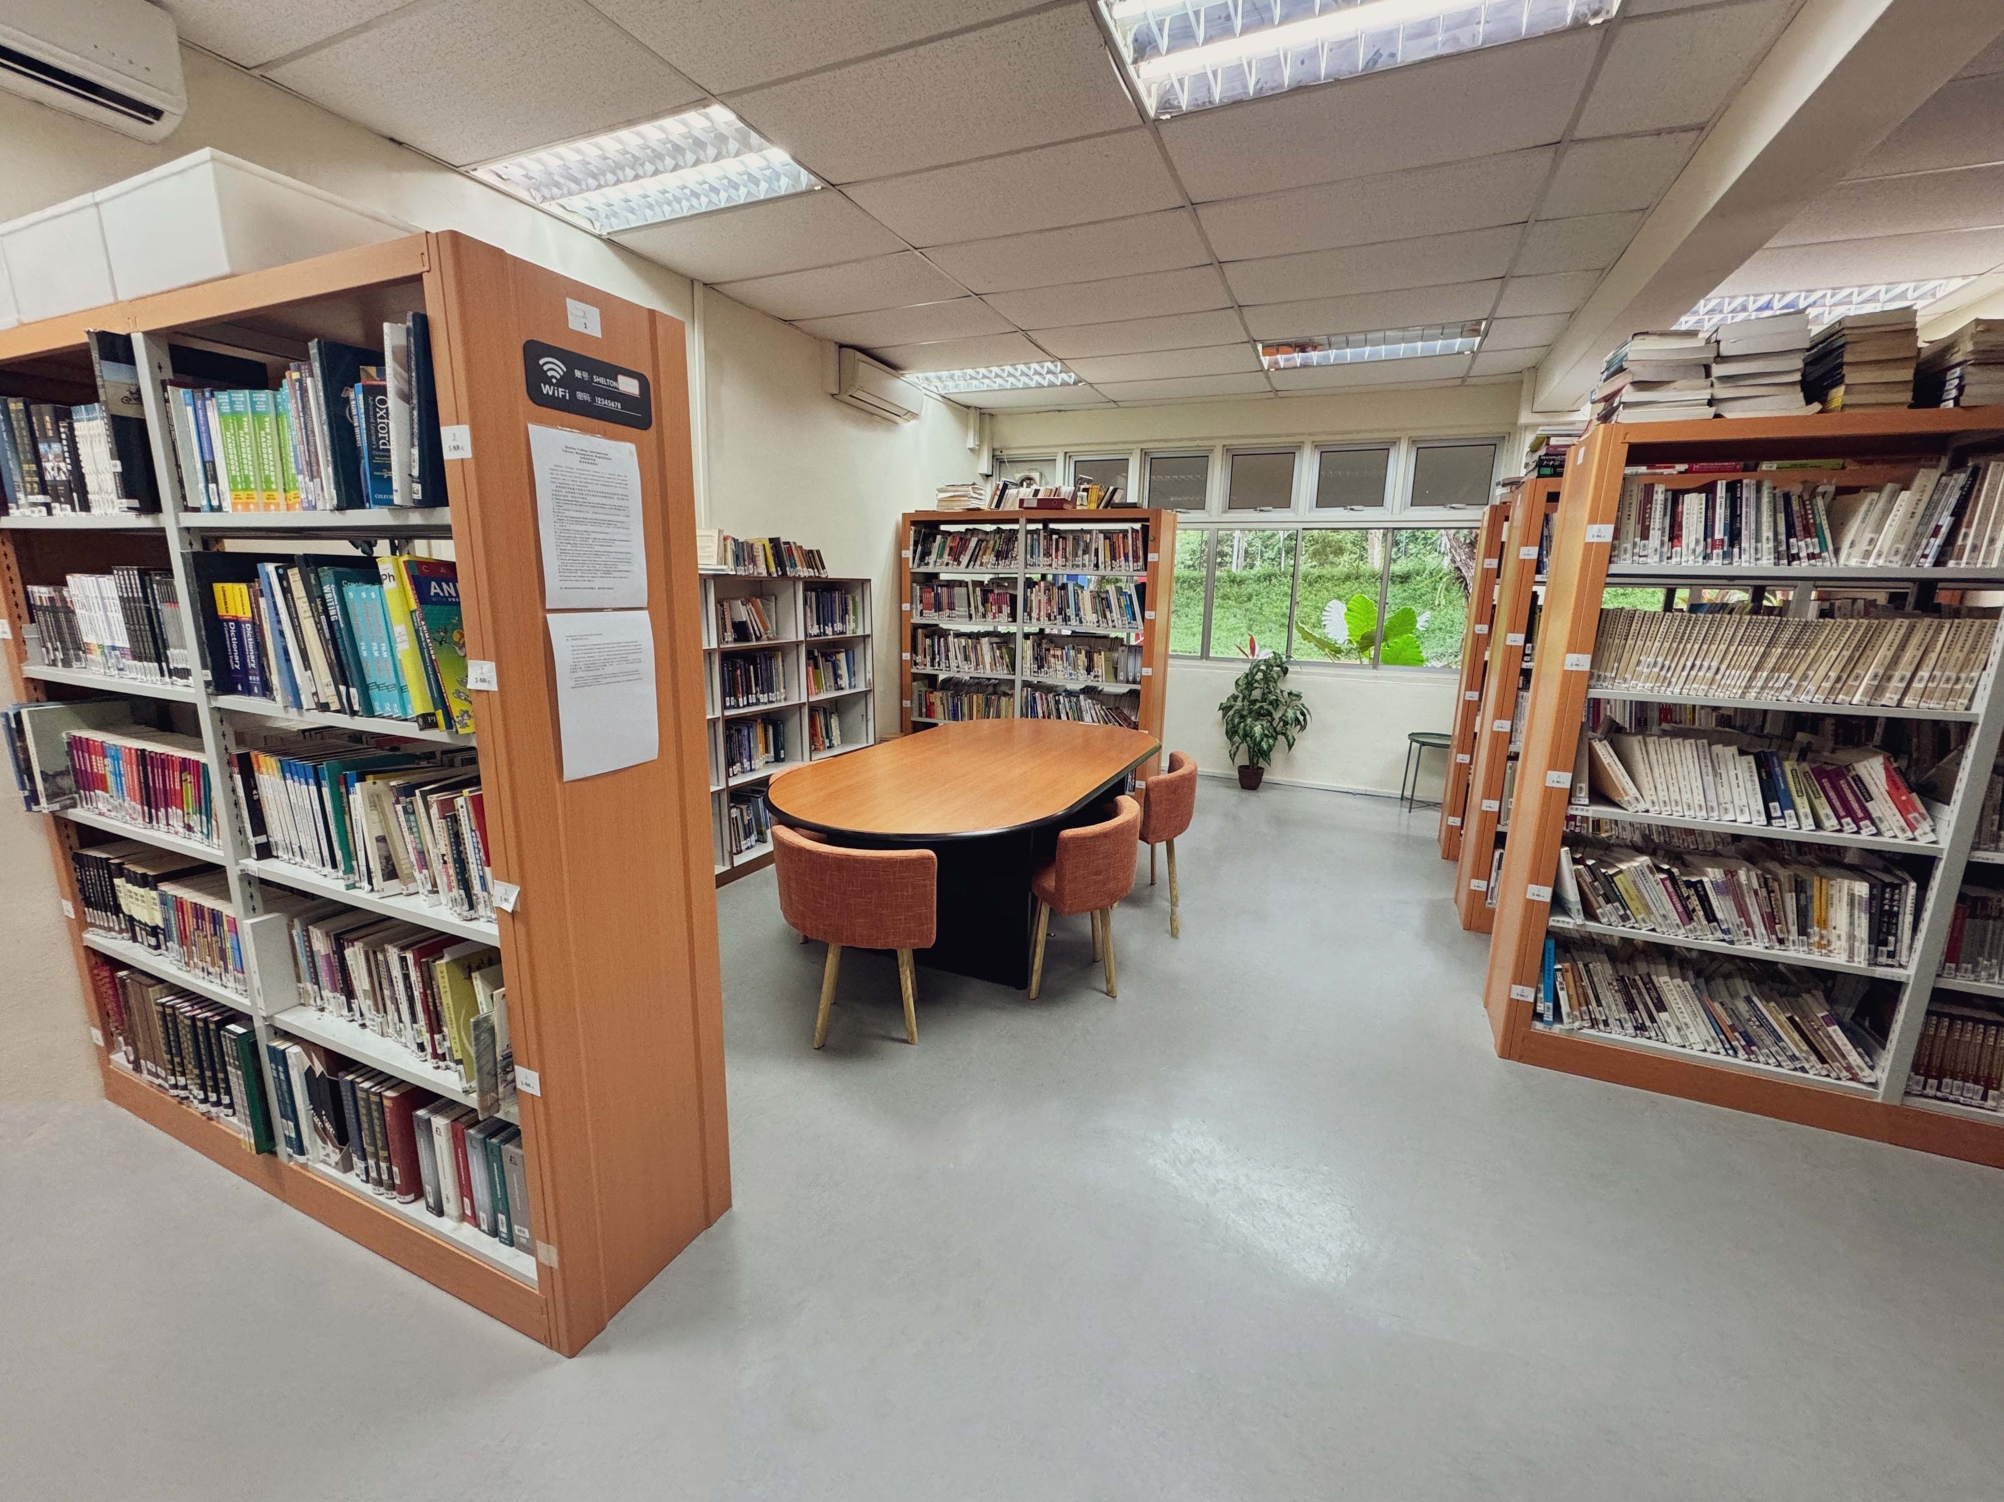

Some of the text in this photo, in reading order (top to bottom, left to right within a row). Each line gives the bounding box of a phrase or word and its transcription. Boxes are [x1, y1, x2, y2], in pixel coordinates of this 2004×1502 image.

[540, 383, 570, 400] WiFi
[594, 396, 621, 410] 12345678
[375, 396, 390, 450] Oxford
[238, 588, 246, 616] LONGMAN
[321, 584, 338, 621] WRITING
[228, 622, 240, 670] Dictionary
[246, 624, 256, 669] Dictionary
[420, 619, 436, 659] ANIMATION
